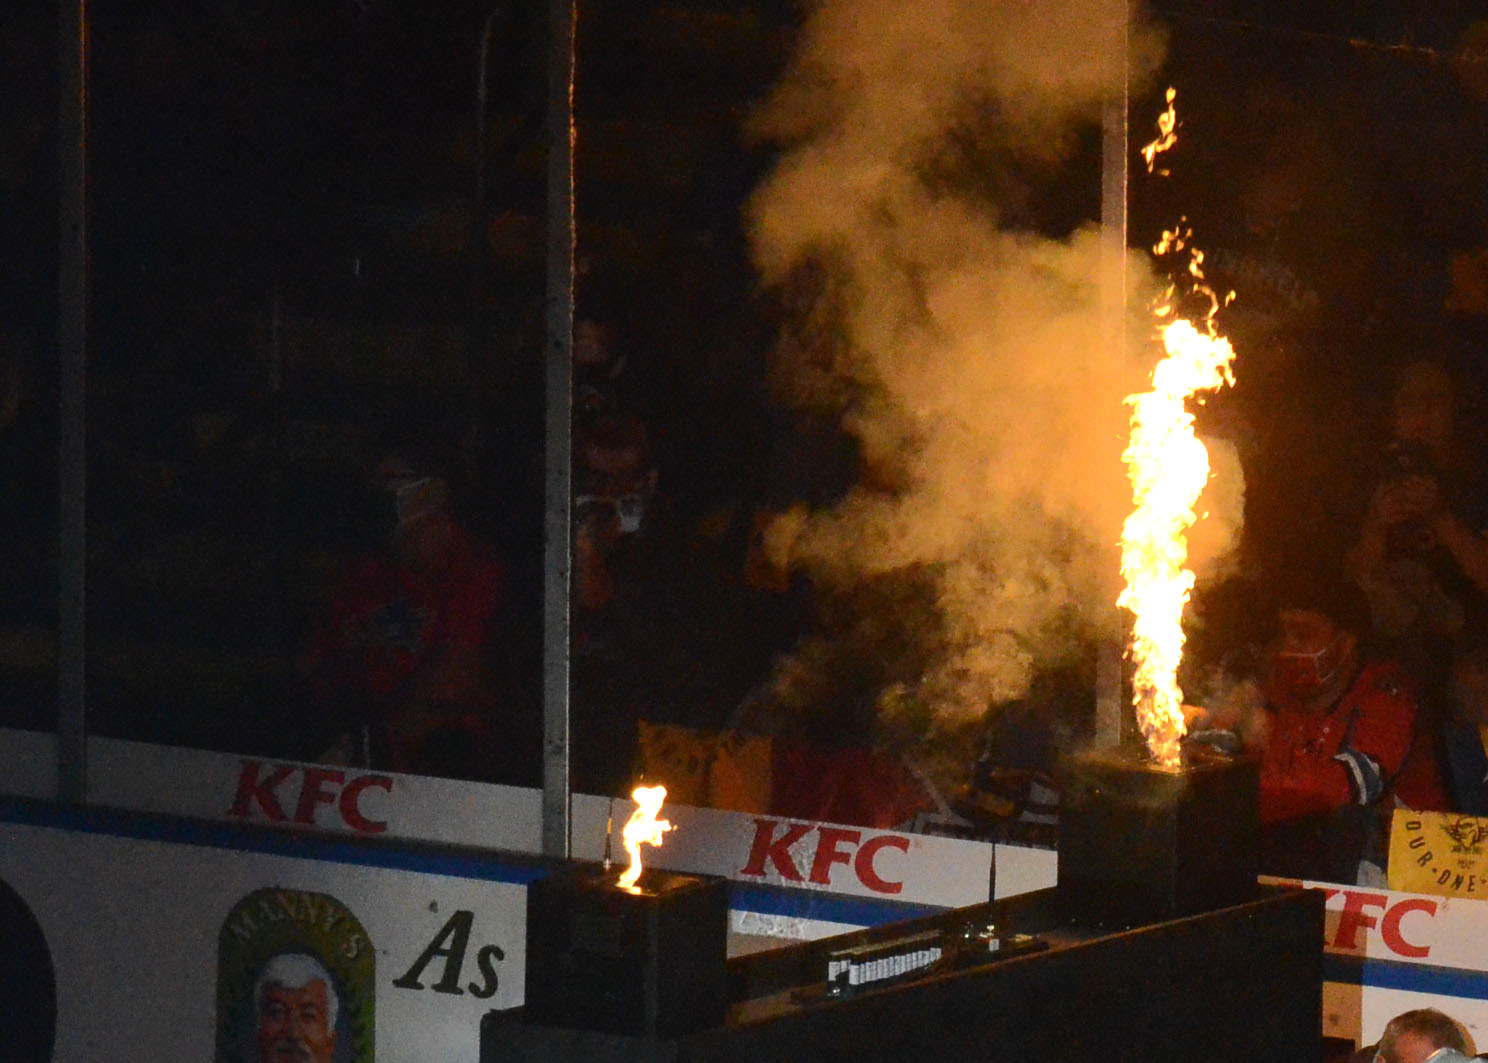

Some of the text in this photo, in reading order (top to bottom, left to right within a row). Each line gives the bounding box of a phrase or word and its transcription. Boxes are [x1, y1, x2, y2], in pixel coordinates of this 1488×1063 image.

[227, 759, 394, 834] KFC
[741, 818, 910, 894] KFC
[1406, 809, 1433, 868] OUR
[1437, 868, 1476, 893] ONE
[229, 894, 364, 959] MANNY'S
[392, 909, 506, 999] As
[1325, 888, 1438, 958] FC
